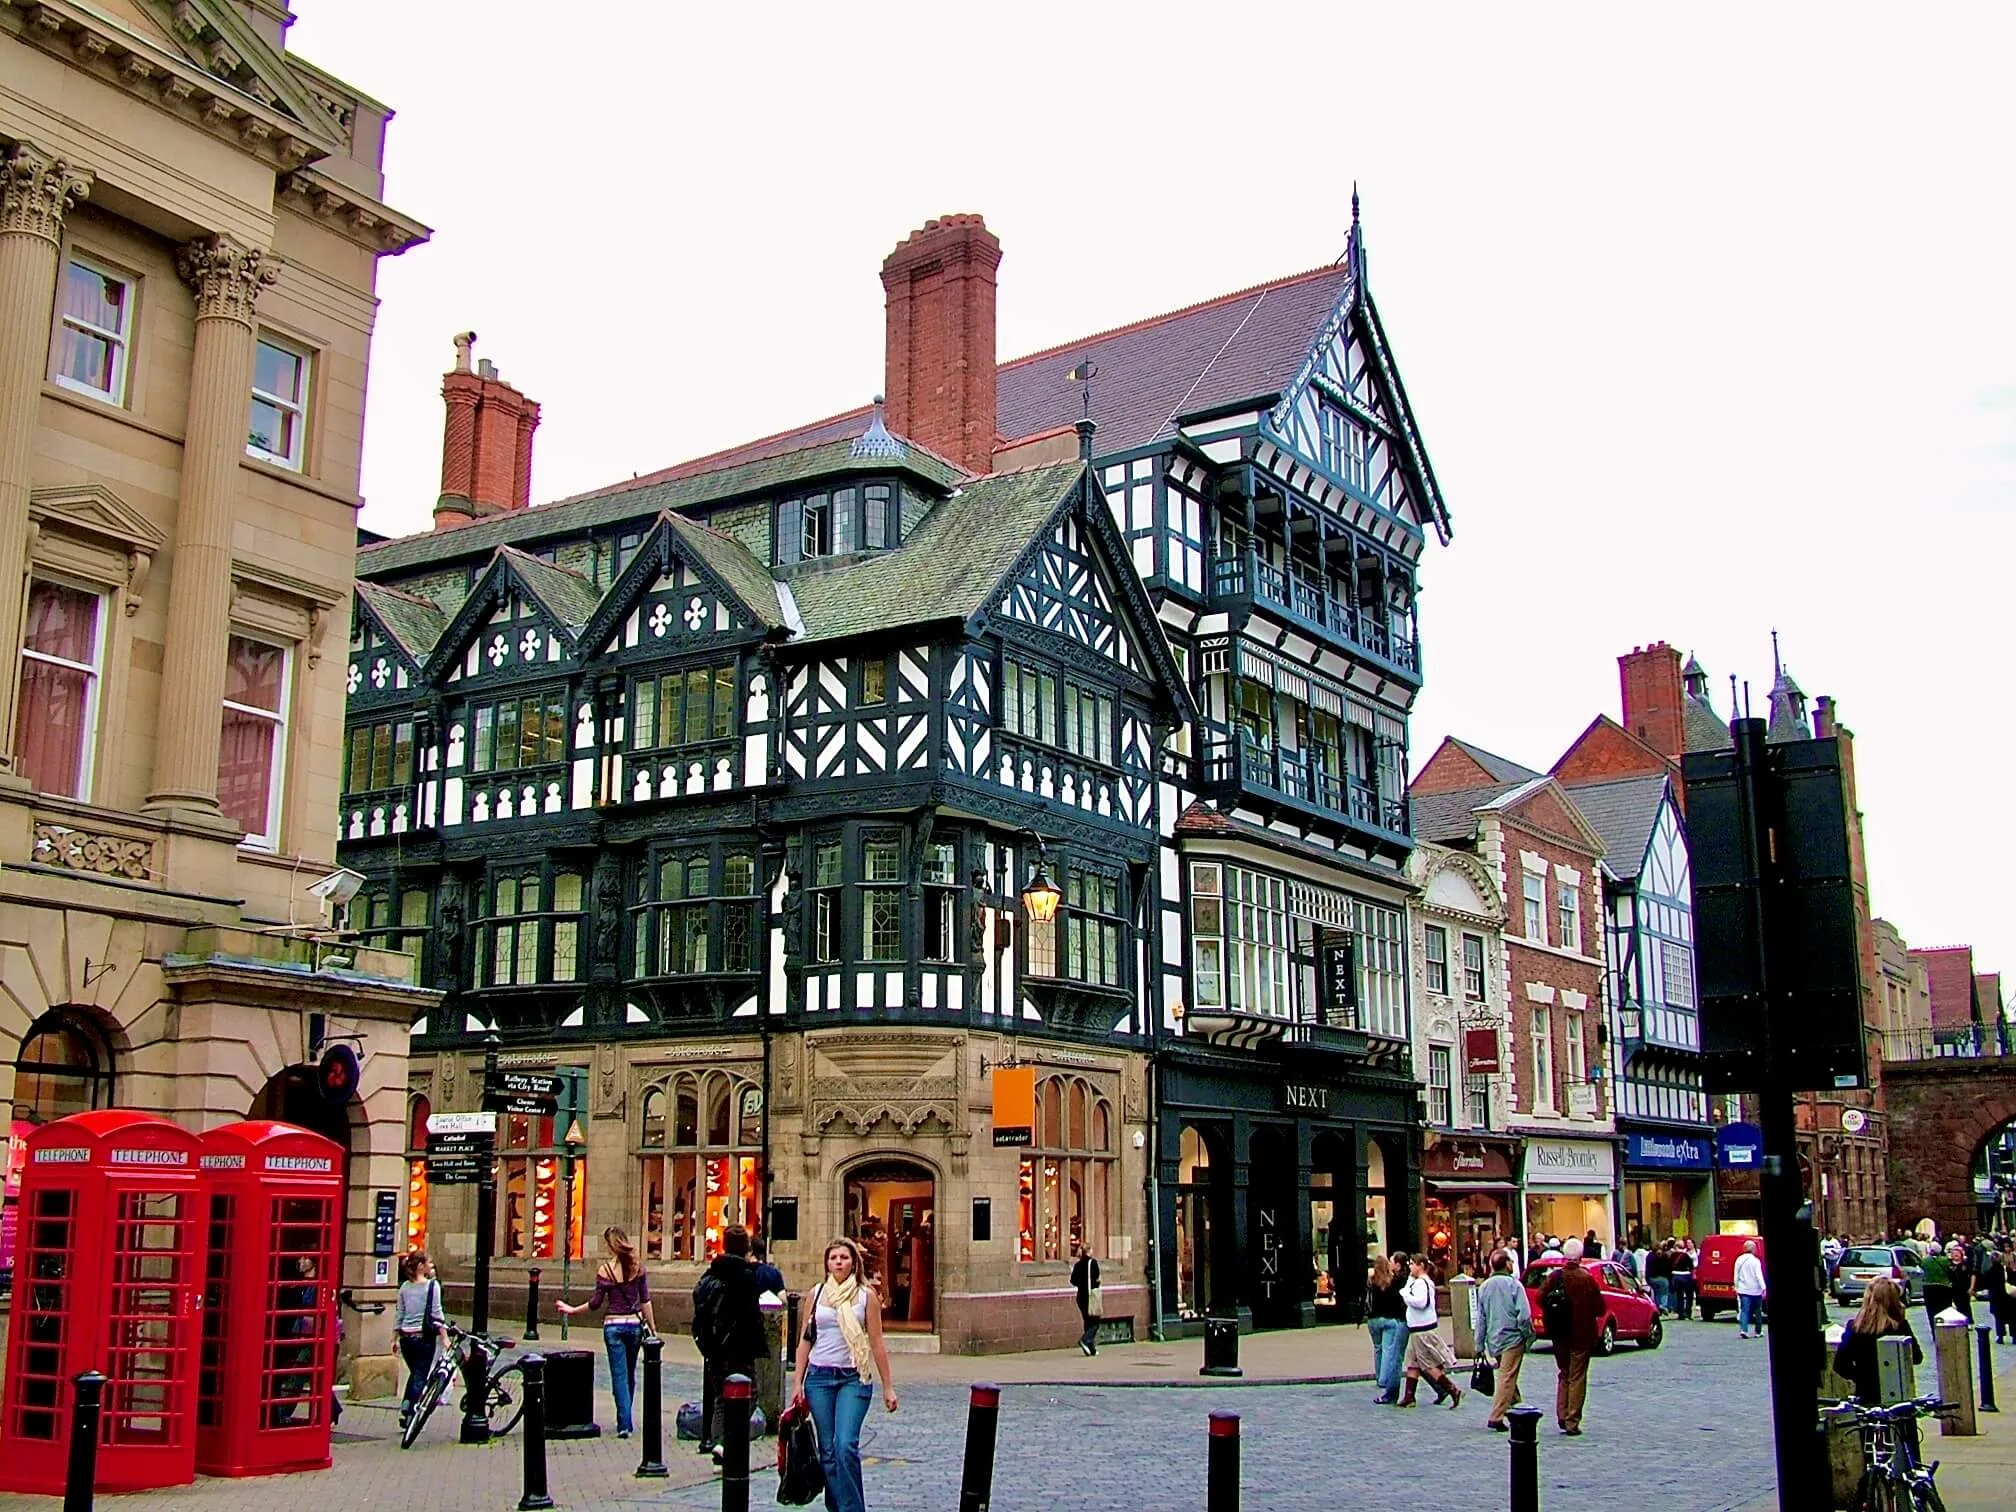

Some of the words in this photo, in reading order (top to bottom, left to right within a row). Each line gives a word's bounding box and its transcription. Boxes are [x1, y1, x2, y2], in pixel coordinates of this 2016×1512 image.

[1334, 949, 1346, 1005] NEXT
[504, 1074, 528, 1085] Railway
[531, 1077, 553, 1086] Station
[517, 1083, 531, 1092] City
[533, 1084, 550, 1093] Road
[1286, 1085, 1328, 1109] NEXT
[37, 1149, 89, 1161] TELEPHONE
[115, 1150, 185, 1164] TELEPHONE
[201, 1155, 243, 1168] LEPHONE
[1537, 1145, 1565, 1167] Russell
[269, 1157, 329, 1169] TELEPHONE
[1260, 1209, 1276, 1299] NEXT
